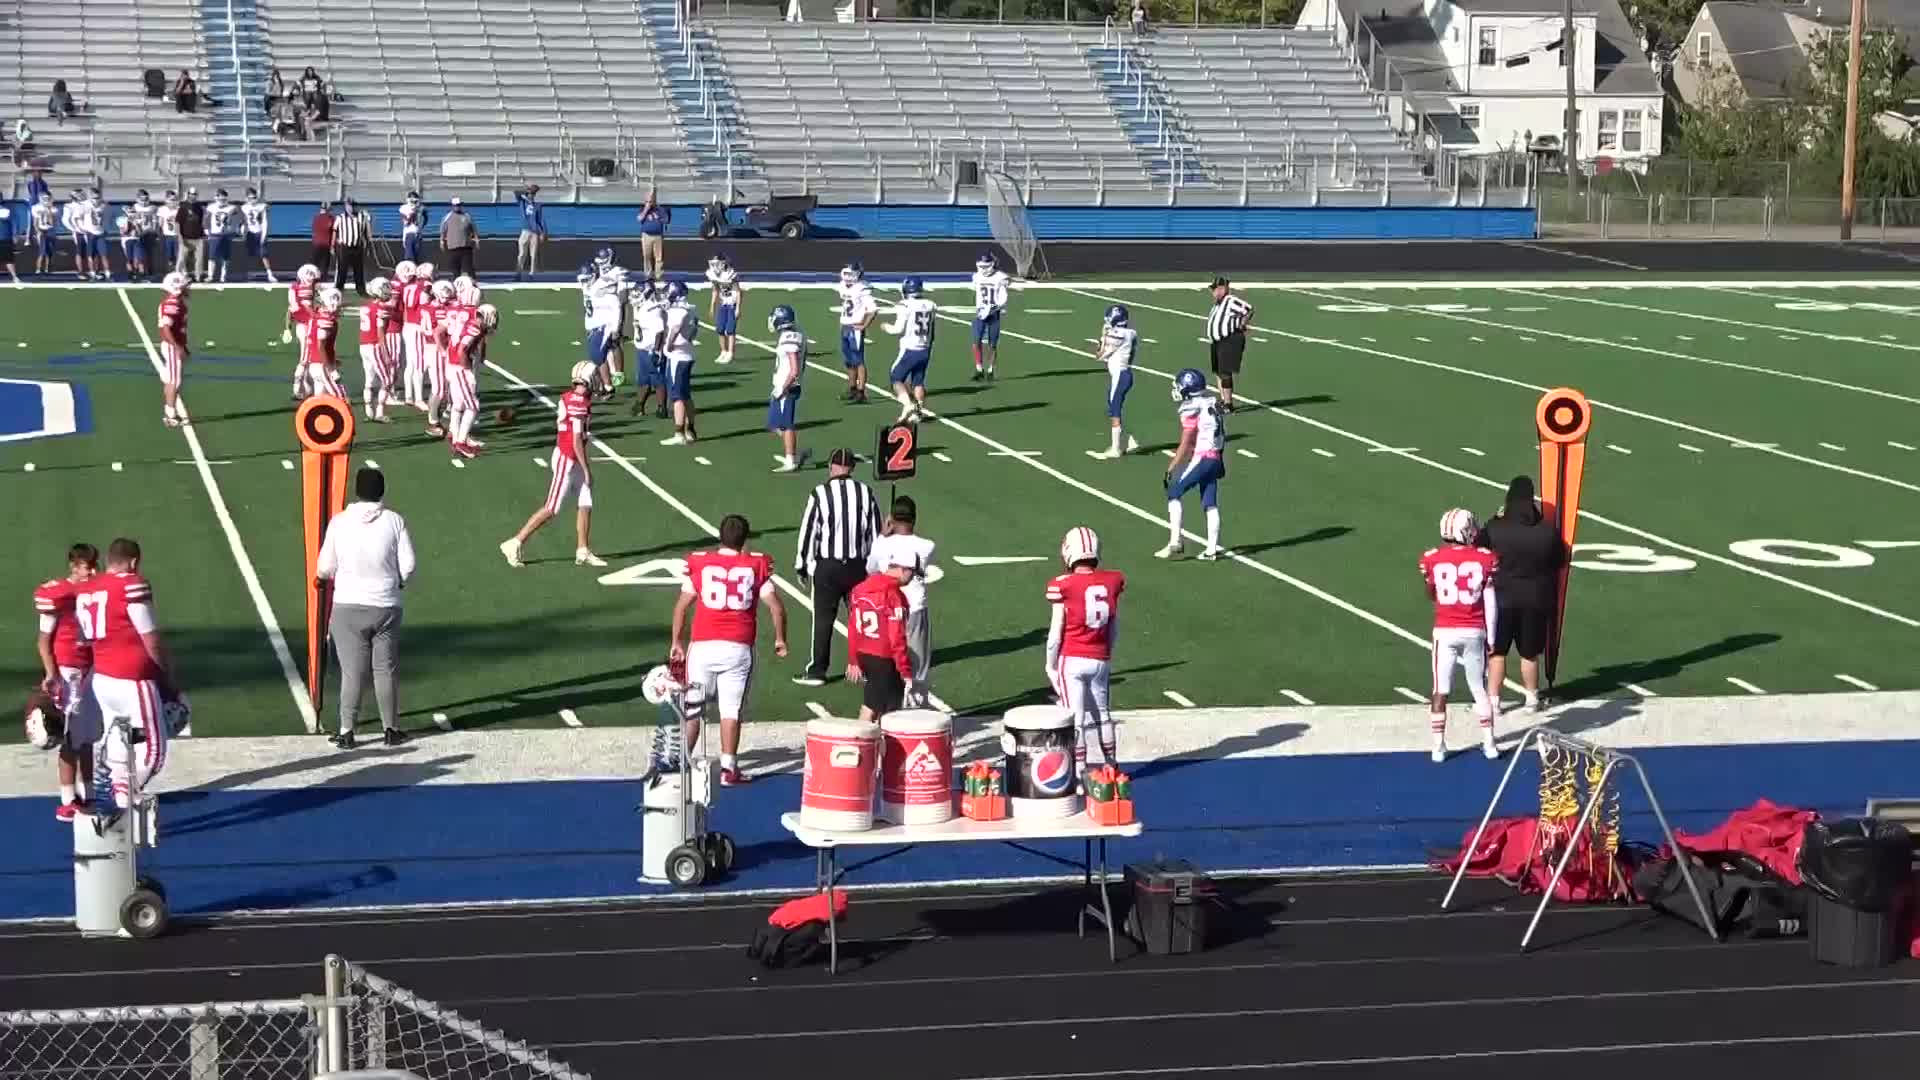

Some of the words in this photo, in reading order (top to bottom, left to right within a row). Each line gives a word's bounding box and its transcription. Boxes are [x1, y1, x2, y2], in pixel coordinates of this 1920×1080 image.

[980, 286, 997, 305] 21
[886, 426, 914, 471] 2
[701, 565, 755, 611] 63
[1433, 561, 1483, 607] 83
[75, 591, 108, 639] 67
[855, 607, 880, 638] 12
[1085, 585, 1110, 629] 6
